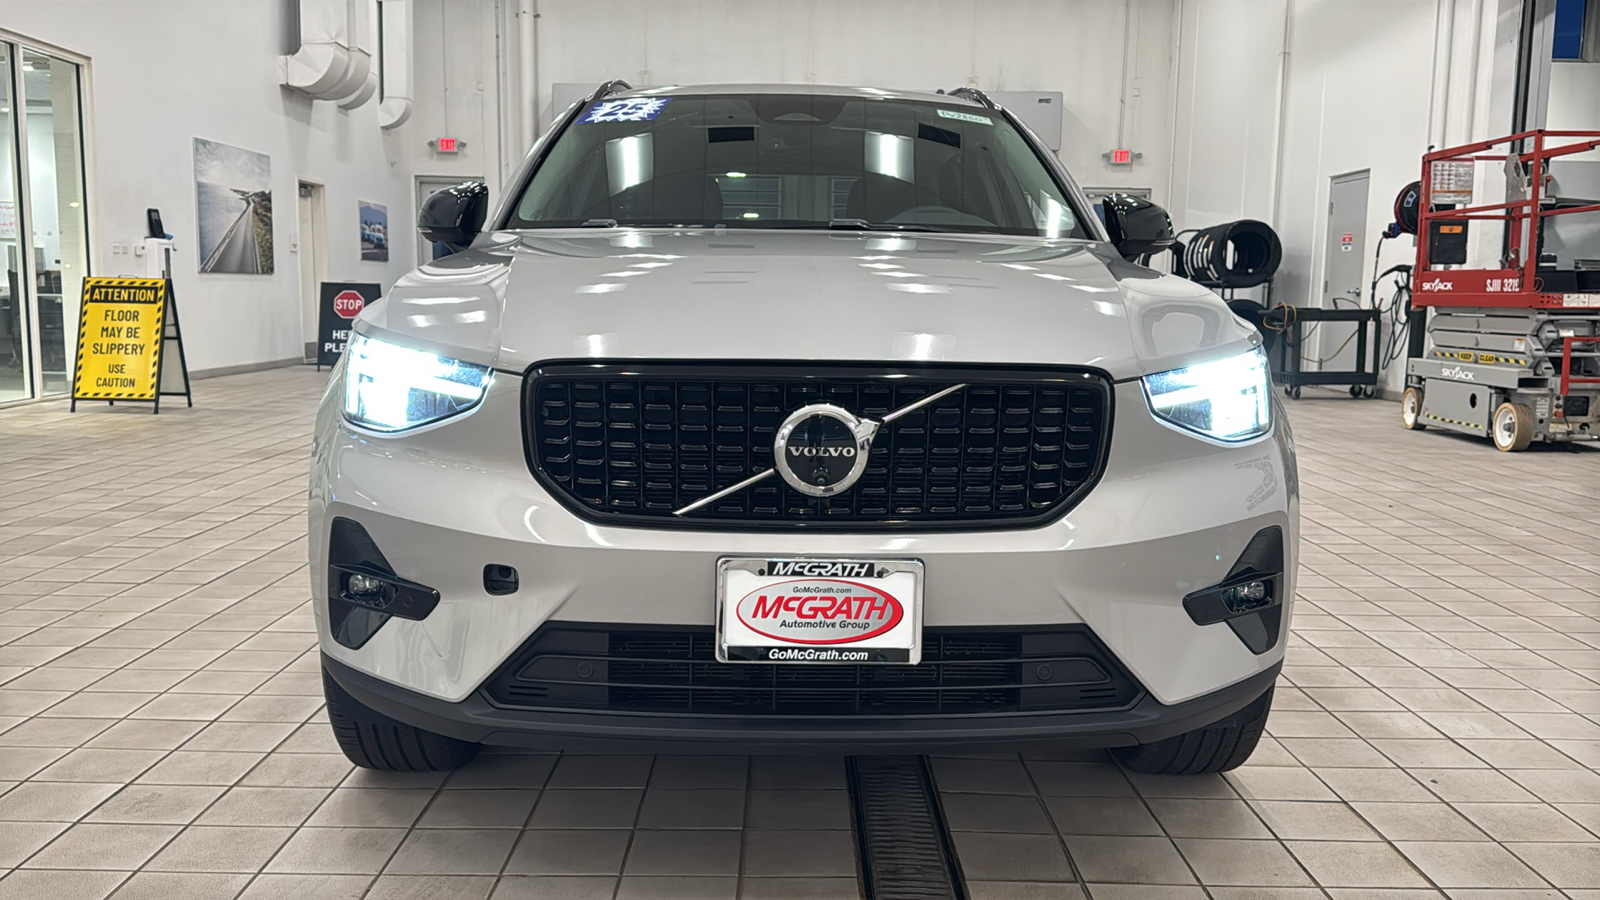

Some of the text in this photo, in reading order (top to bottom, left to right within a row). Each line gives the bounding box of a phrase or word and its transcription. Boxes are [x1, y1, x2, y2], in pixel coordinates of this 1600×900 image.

[600, 102, 649, 117] 25
[1422, 278, 1453, 293] SKYJACK
[92, 288, 155, 302] ATTENTION
[336, 299, 362, 310] STOP
[104, 309, 140, 322] FLOOR
[100, 326, 140, 339] MAY BE
[332, 329, 350, 340] HE
[92, 343, 145, 355] SLIPPERY
[324, 342, 347, 353] PLE
[108, 364, 126, 374] USE
[1441, 366, 1475, 381] SKYJACK
[96, 377, 136, 388] CAUTION
[787, 446, 856, 457] VOLVO
[792, 586, 852, 595] GoMcGrath.com
[779, 620, 870, 631] Automotive Group
[768, 648, 869, 661] GoMcGrath.com
